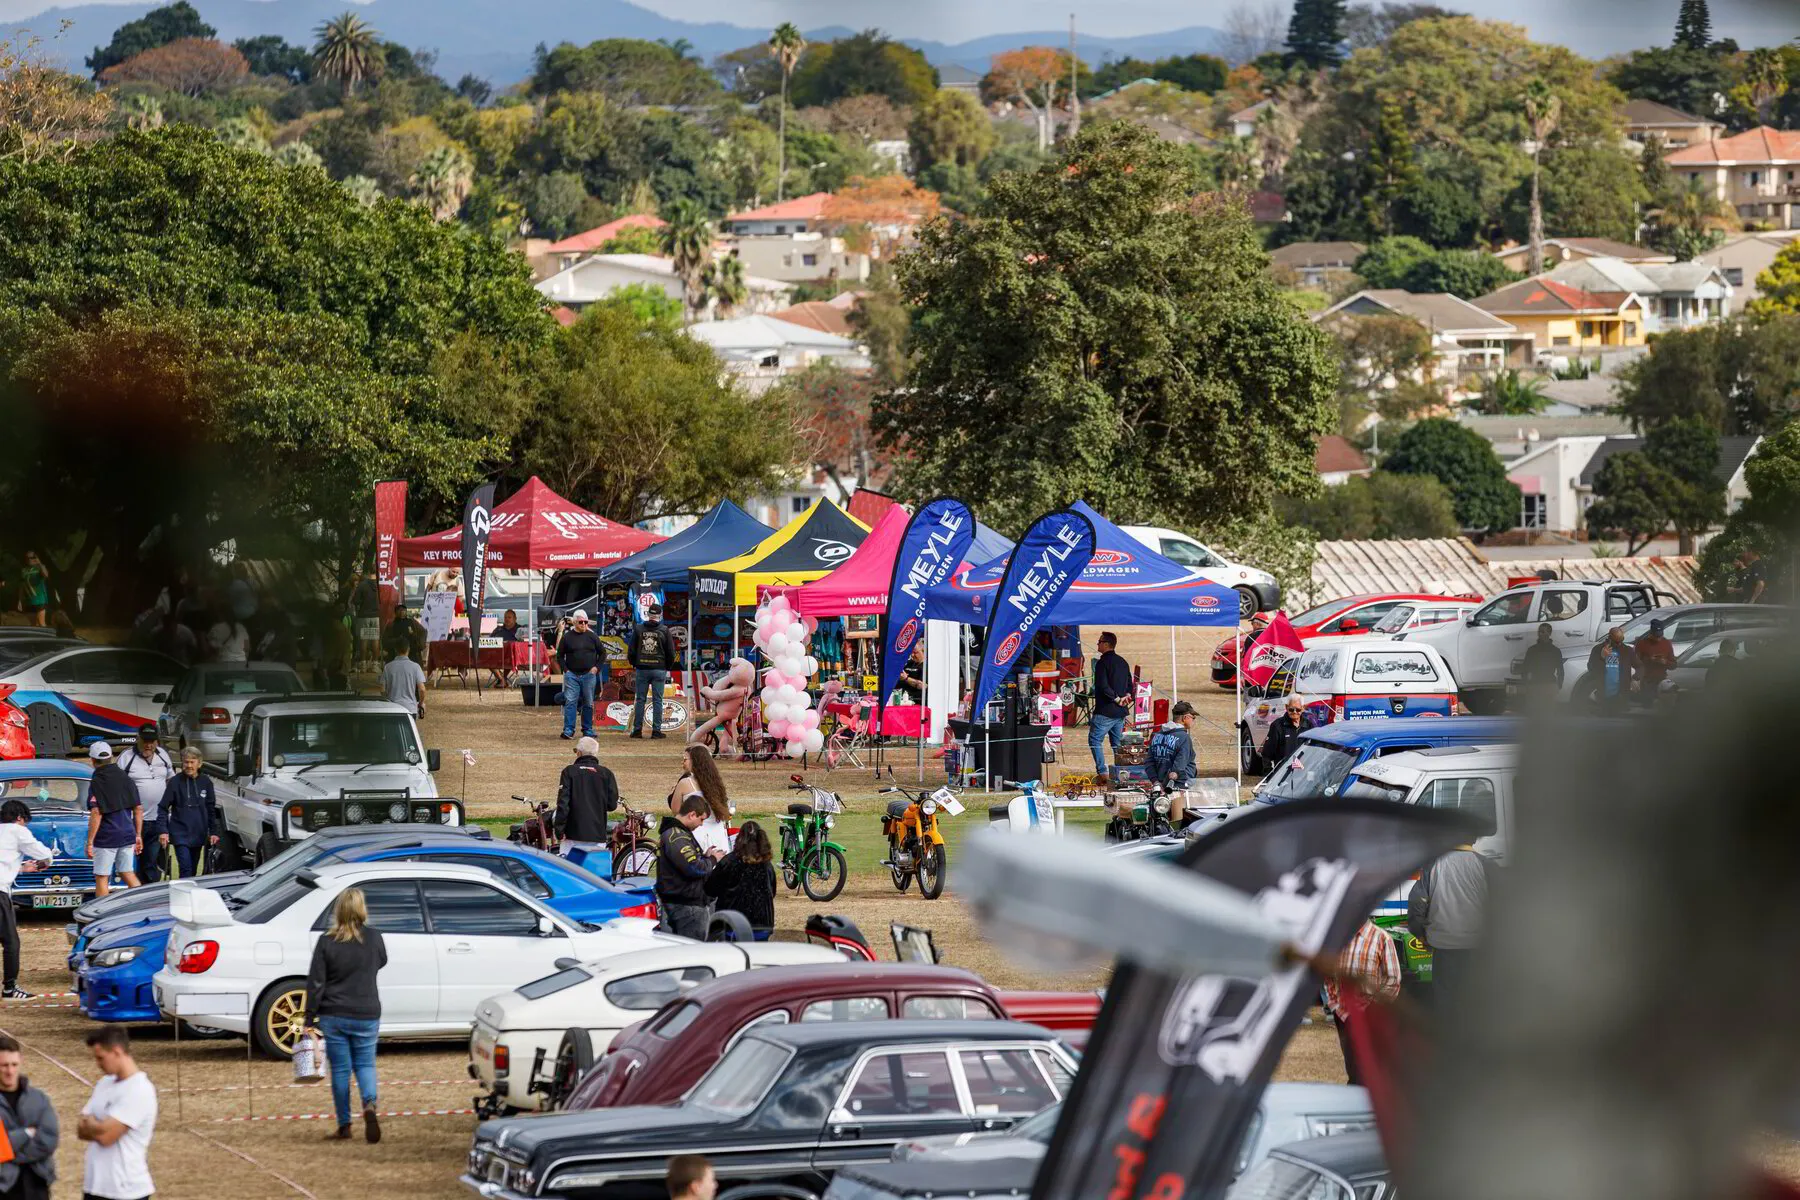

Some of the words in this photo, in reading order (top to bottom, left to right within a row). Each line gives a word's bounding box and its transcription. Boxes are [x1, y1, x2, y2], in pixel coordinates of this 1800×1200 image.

[541, 511, 609, 531] EDDIE
[379, 533, 393, 586] EDDIE
[423, 551, 439, 561] KEY
[442, 550, 503, 561] PROGING
[549, 552, 585, 561] Commercial
[593, 551, 622, 559] Industrial
[901, 509, 964, 599] MEYLE
[1008, 524, 1084, 613] MEYLE
[471, 540, 485, 609] CARTRACK
[700, 578, 728, 596] DUNLOP
[1019, 570, 1068, 632] GOLDWAGEN
[52, 896, 68, 906] 219
[71, 895, 81, 906] EC
